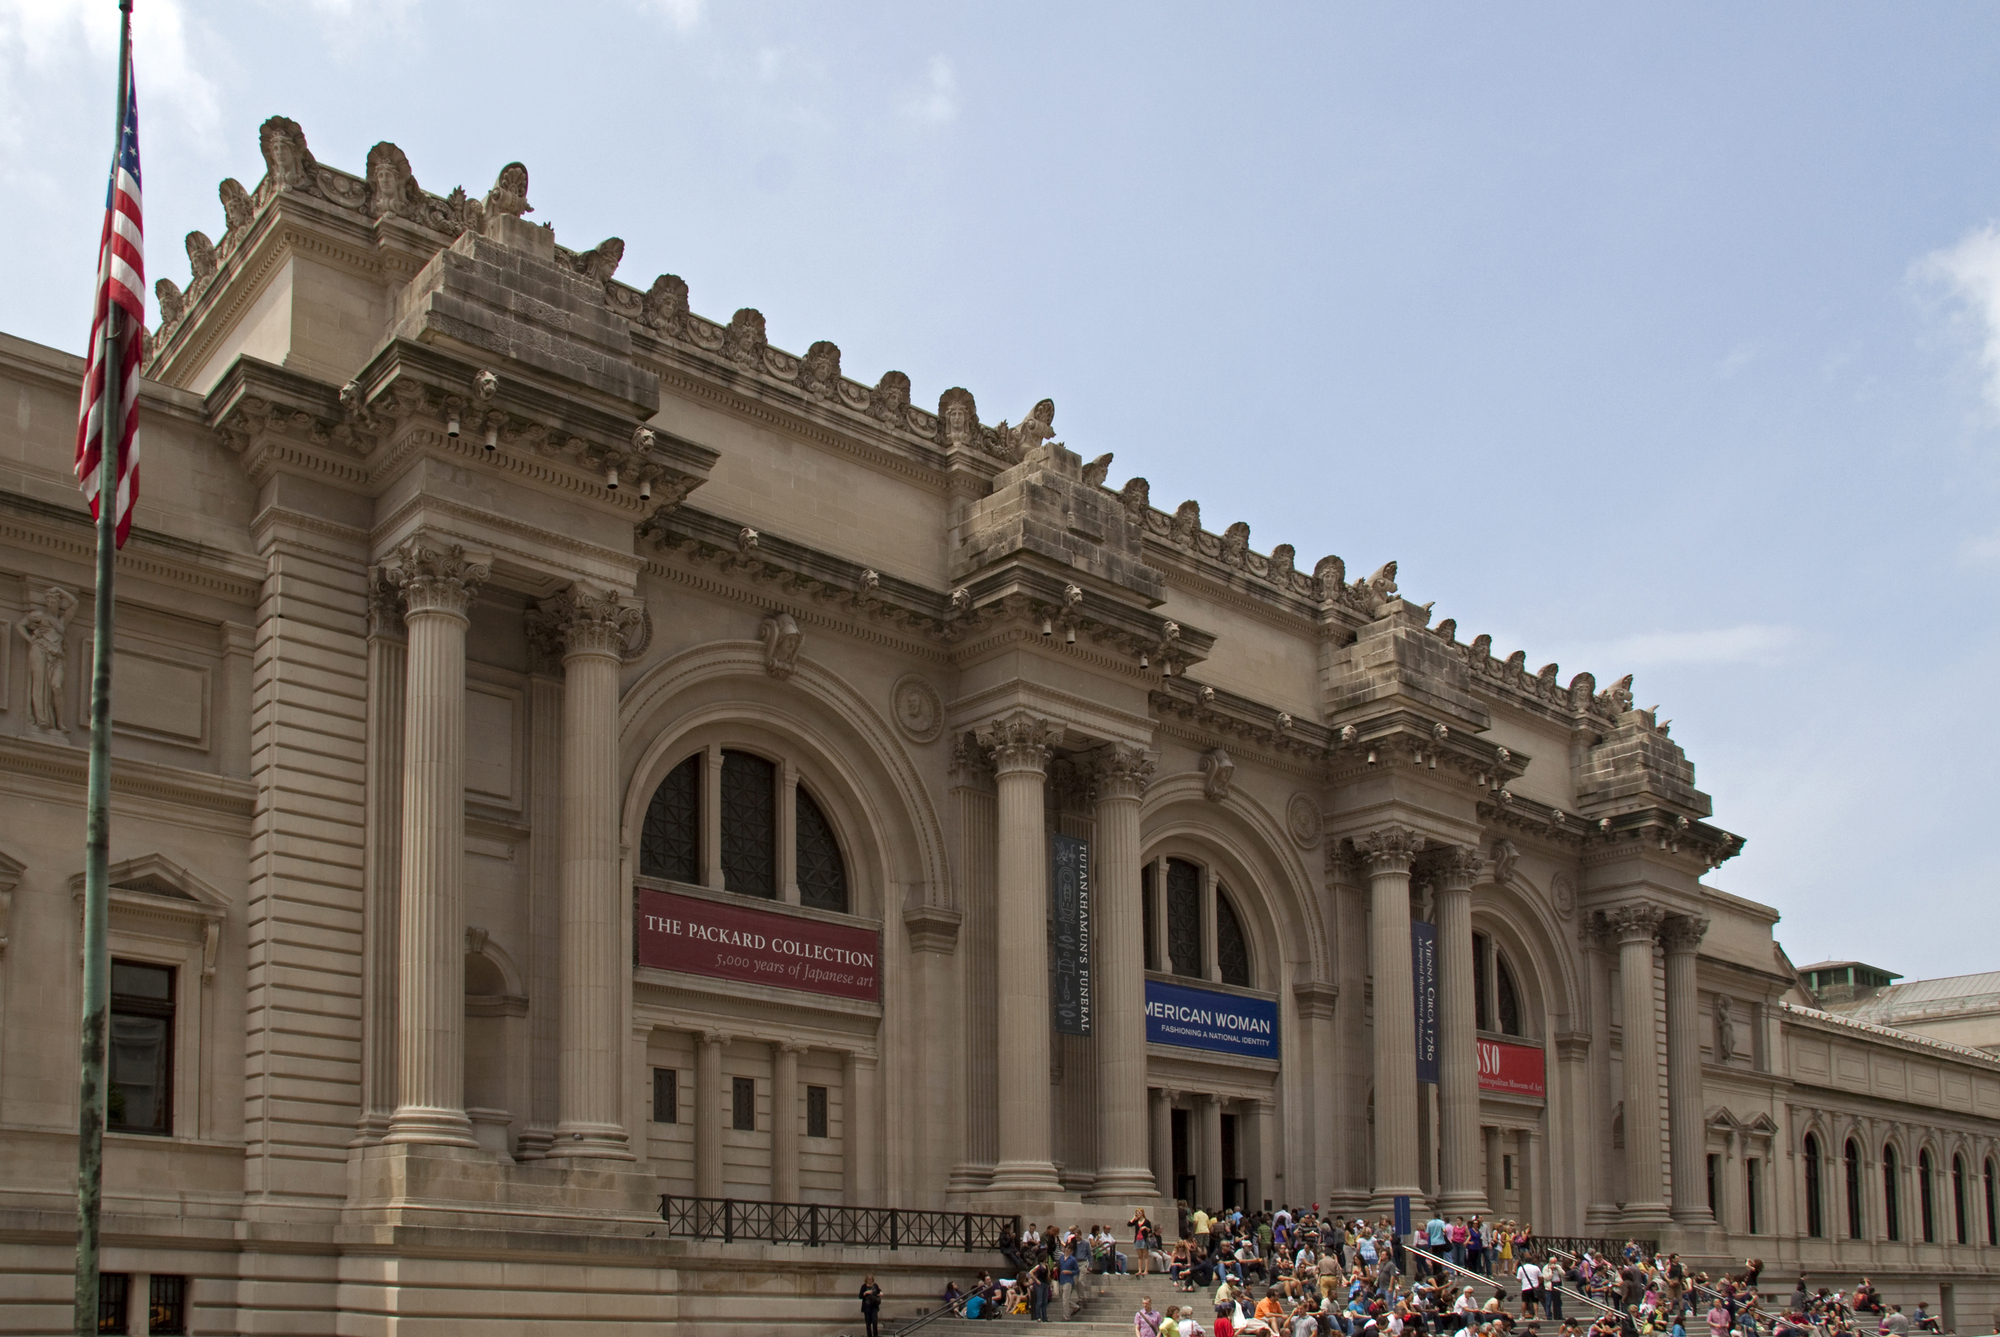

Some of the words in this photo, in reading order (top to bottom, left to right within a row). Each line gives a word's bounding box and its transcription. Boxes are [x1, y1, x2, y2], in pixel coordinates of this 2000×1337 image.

[1079, 845, 1089, 964] TUTANKHAMUN'S
[644, 915, 683, 935] THE
[688, 923, 766, 950] PACKARD
[772, 938, 875, 968] COLLECTION
[715, 954, 750, 969] 5,000
[753, 957, 785, 974] years
[788, 962, 803, 980] of
[802, 964, 854, 985] Japanese
[856, 975, 874, 988] art
[1079, 970, 1090, 1031] FUNERAL
[1161, 1024, 1202, 1037] FASHIONING
[1208, 1032, 1241, 1043] NATIONAL
[1241, 1036, 1270, 1047] IDENTITY
[1215, 1012, 1270, 1034] WOMAN
[1425, 1028, 1435, 1061] 1780
[1509, 1079, 1529, 1089] Museum
[1529, 1082, 1534, 1090] of
[1534, 1083, 1543, 1092] Art
